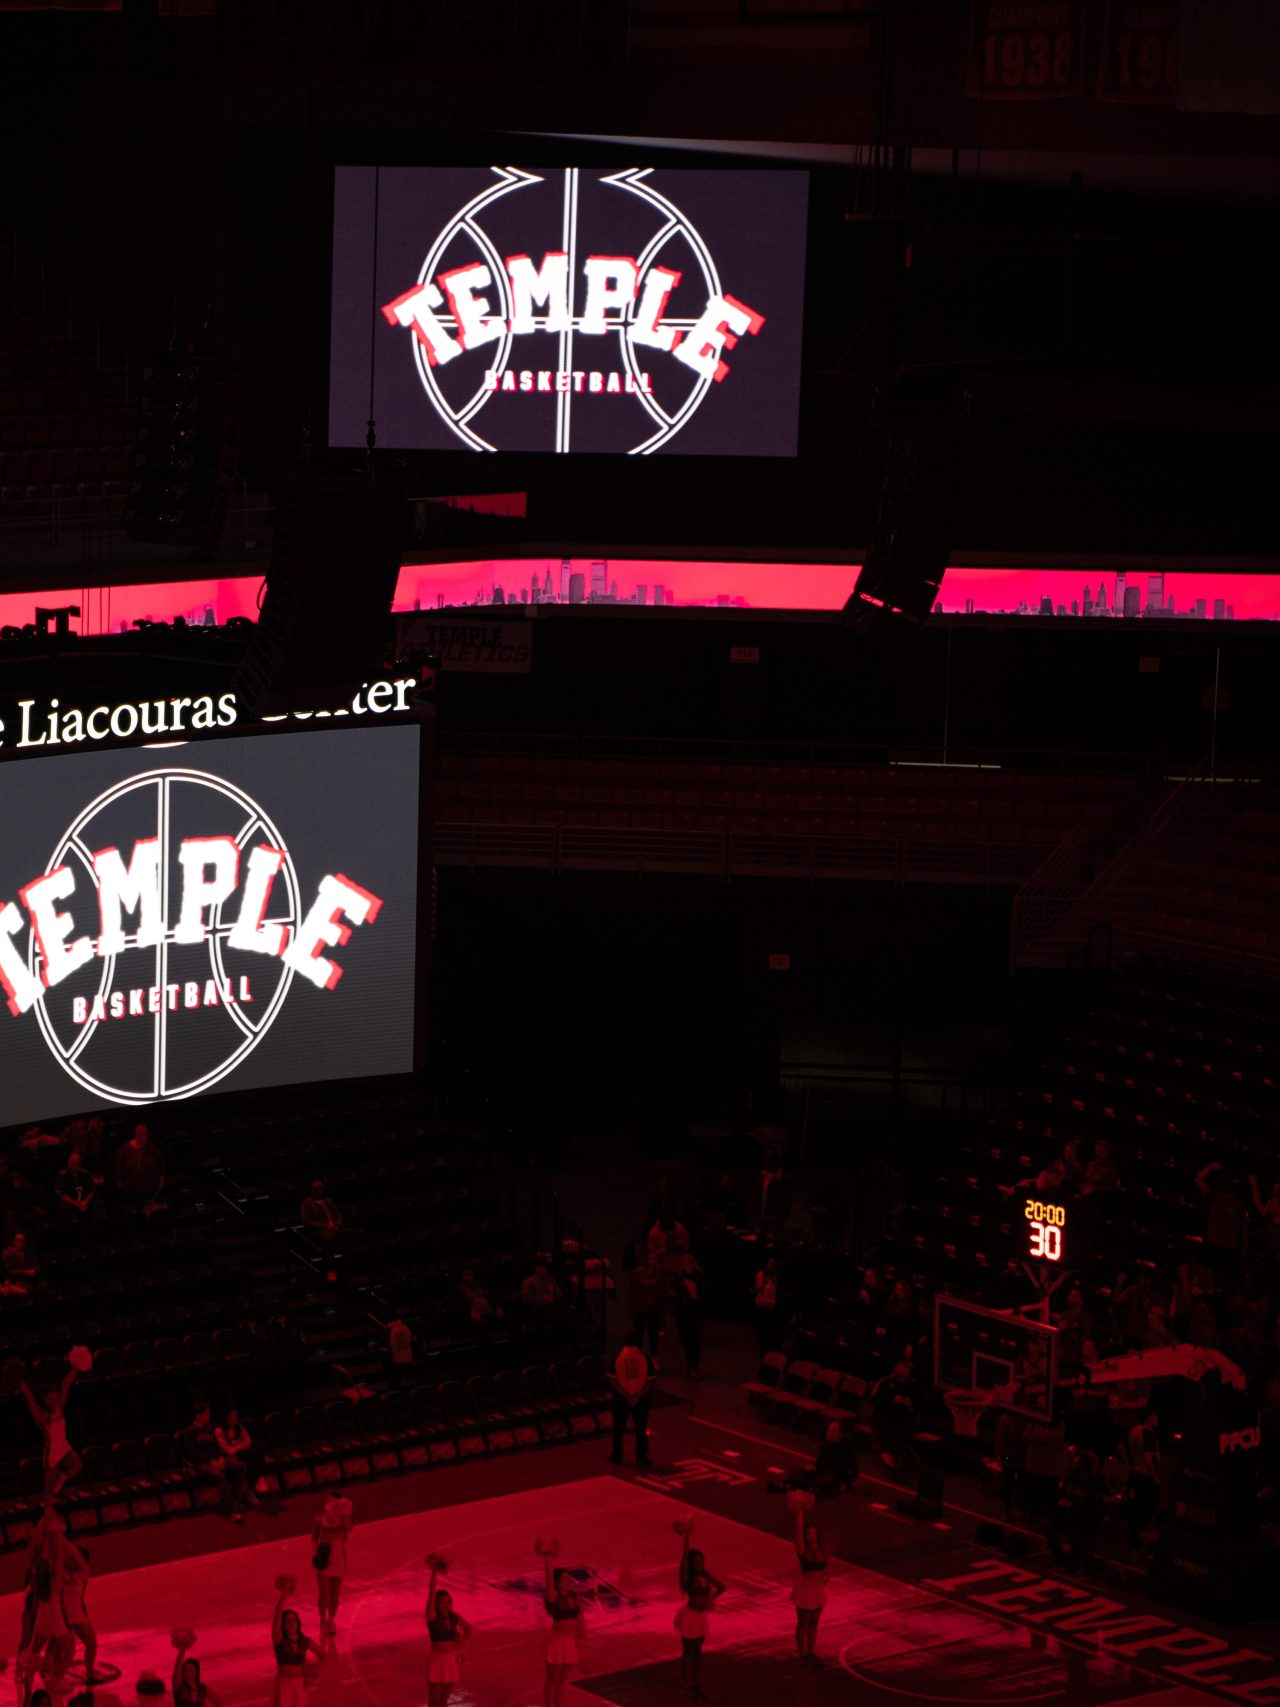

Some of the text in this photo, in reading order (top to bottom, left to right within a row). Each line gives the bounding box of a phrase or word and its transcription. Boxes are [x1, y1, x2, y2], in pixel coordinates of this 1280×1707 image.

[982, 31, 1073, 88] 1938
[381, 251, 766, 383] TEMPLE
[485, 369, 654, 394] BASKETBALL
[426, 625, 503, 648] TEMPLE
[16, 693, 237, 749] Liacouras
[72, 975, 254, 1024] BASKETBALL
[1024, 1199, 1066, 1227] 20:00
[1029, 1221, 1061, 1261] 30
